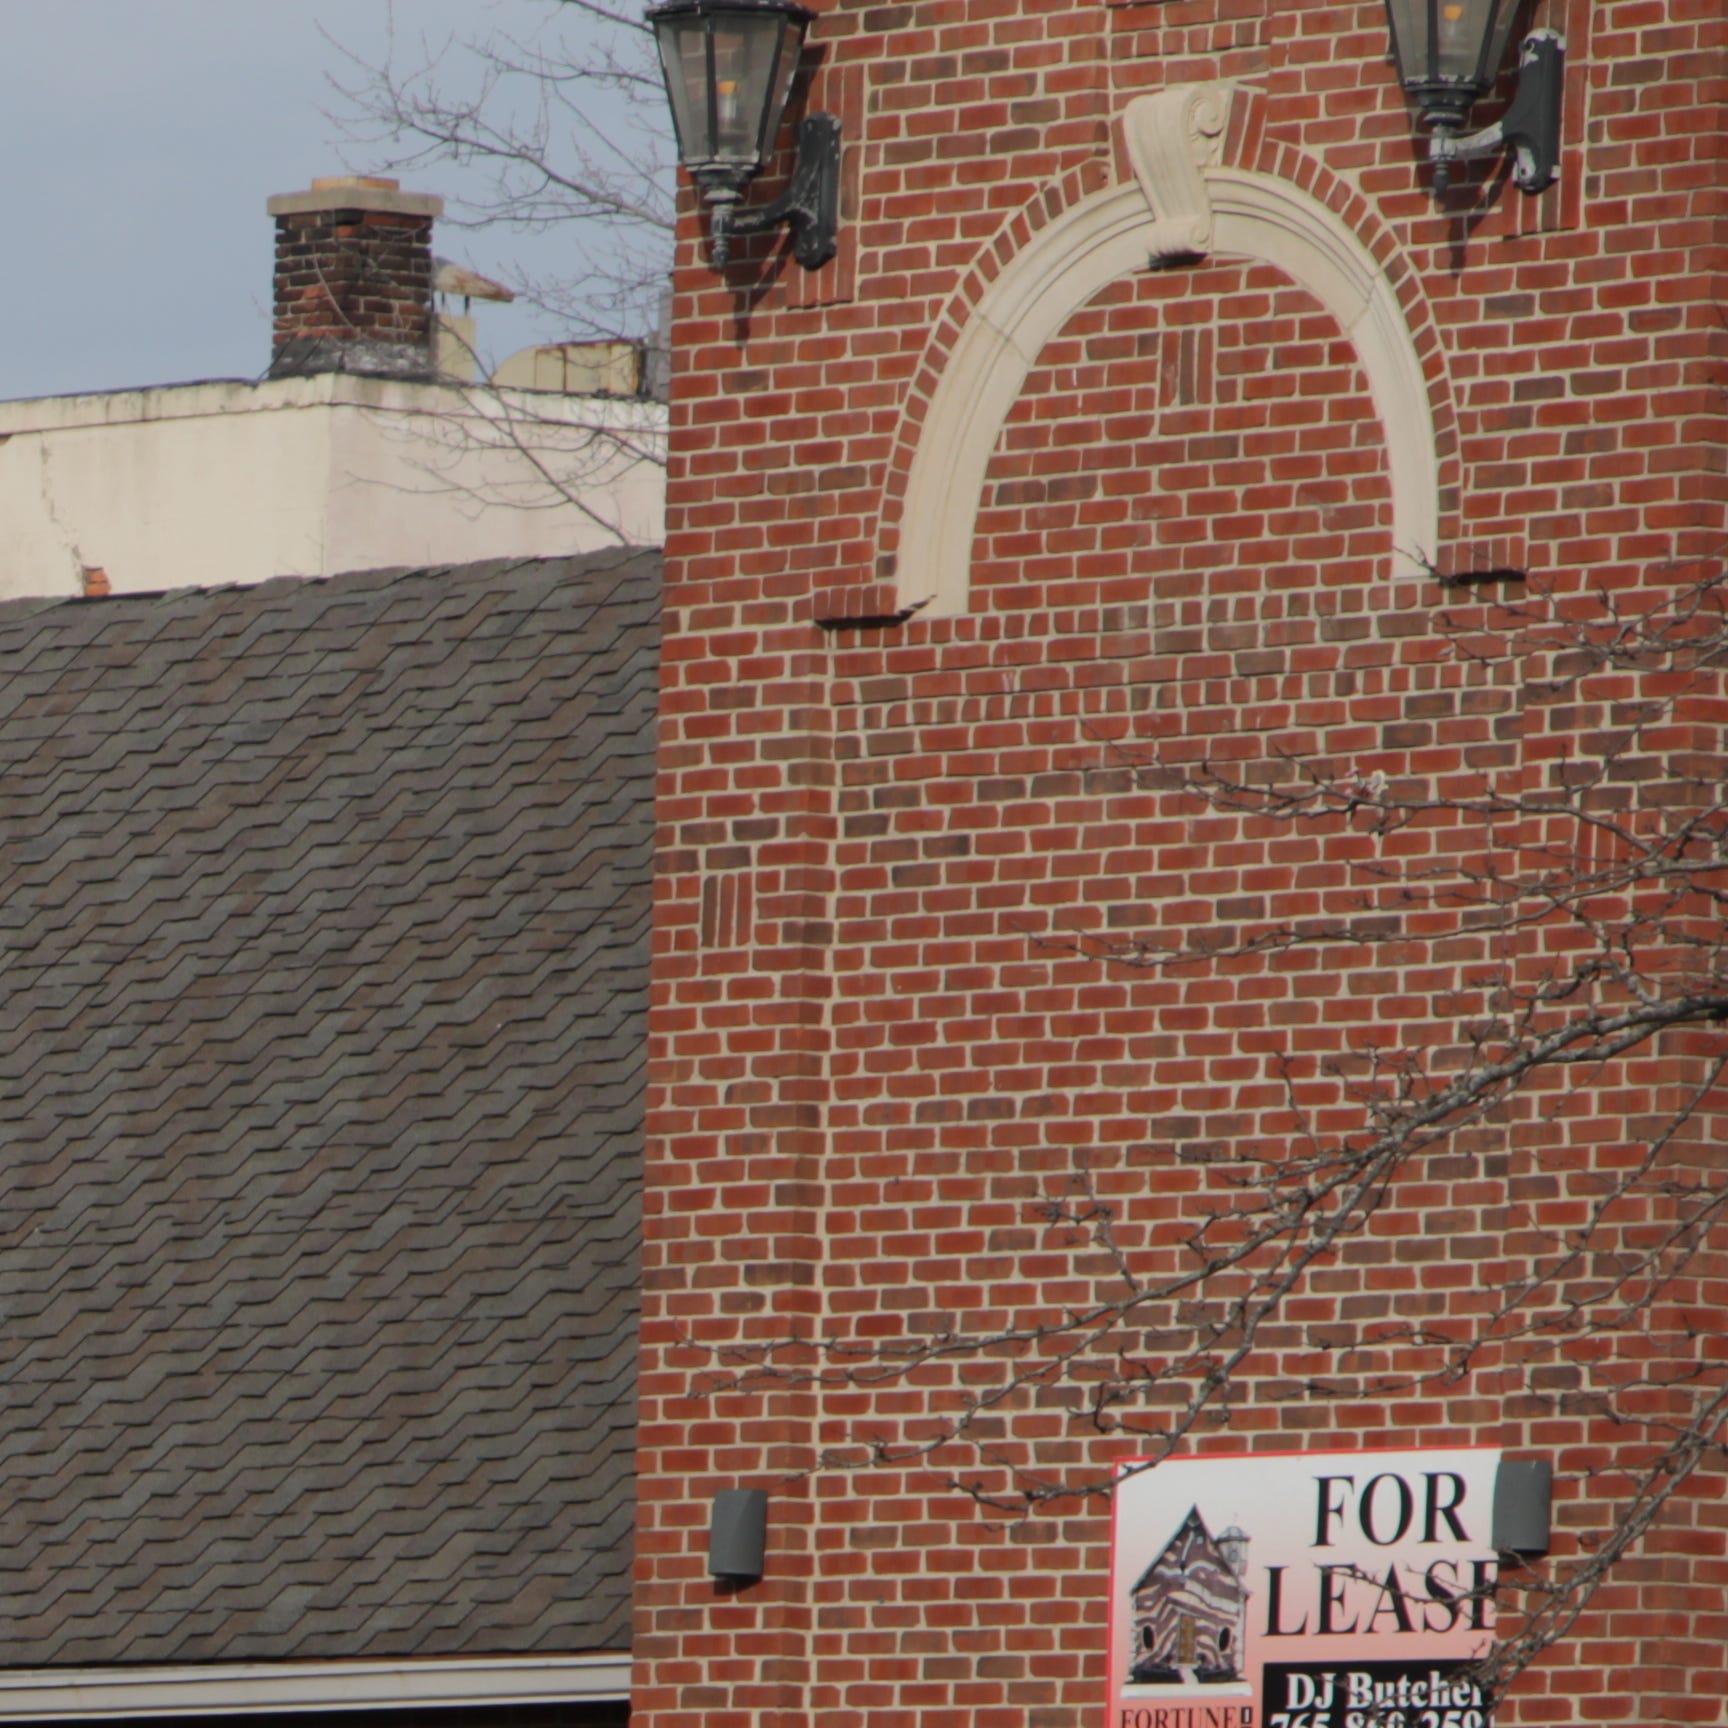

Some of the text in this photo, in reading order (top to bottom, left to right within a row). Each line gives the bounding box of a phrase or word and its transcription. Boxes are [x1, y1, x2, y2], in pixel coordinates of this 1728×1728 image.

[1311, 1472, 1472, 1547] FOR
[1261, 1559, 1497, 1637] LEASE
[1286, 1673, 1337, 1710] DJ
